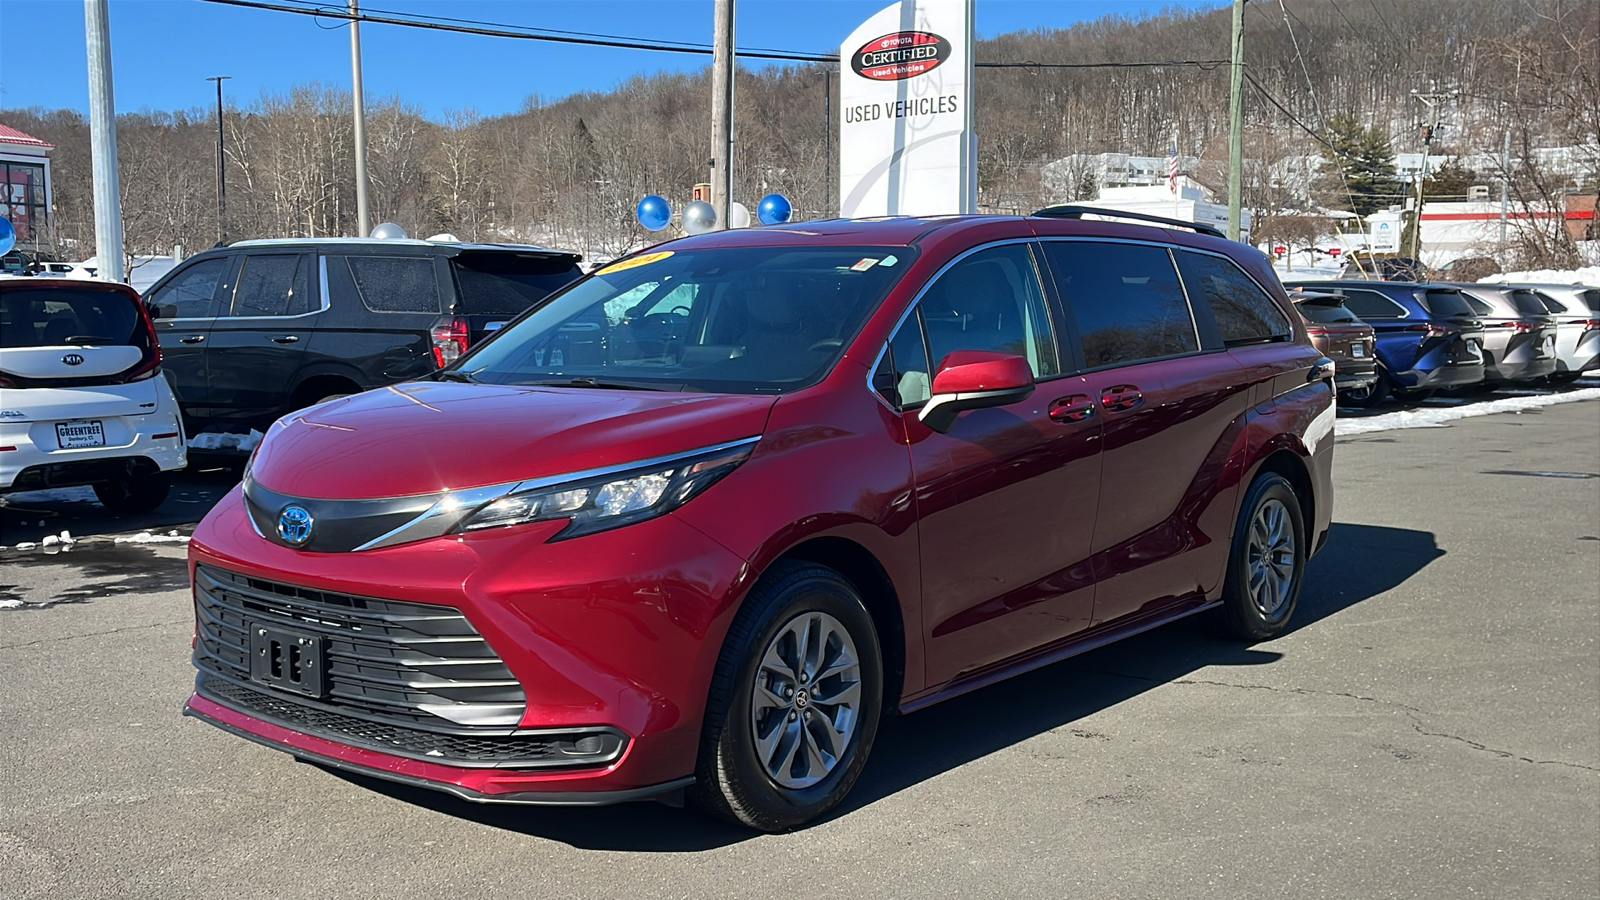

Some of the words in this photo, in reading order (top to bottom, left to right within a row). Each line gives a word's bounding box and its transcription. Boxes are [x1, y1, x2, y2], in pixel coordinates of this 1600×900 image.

[889, 37, 912, 46] TOYOTA
[861, 46, 938, 67] CERTIFIED
[873, 68, 891, 77] Used
[892, 64, 925, 74] Vehicles
[845, 103, 880, 123] USED
[885, 95, 957, 119] VEHICLES
[65, 356, 82, 364] KIA
[60, 426, 100, 437] GREENTREE
